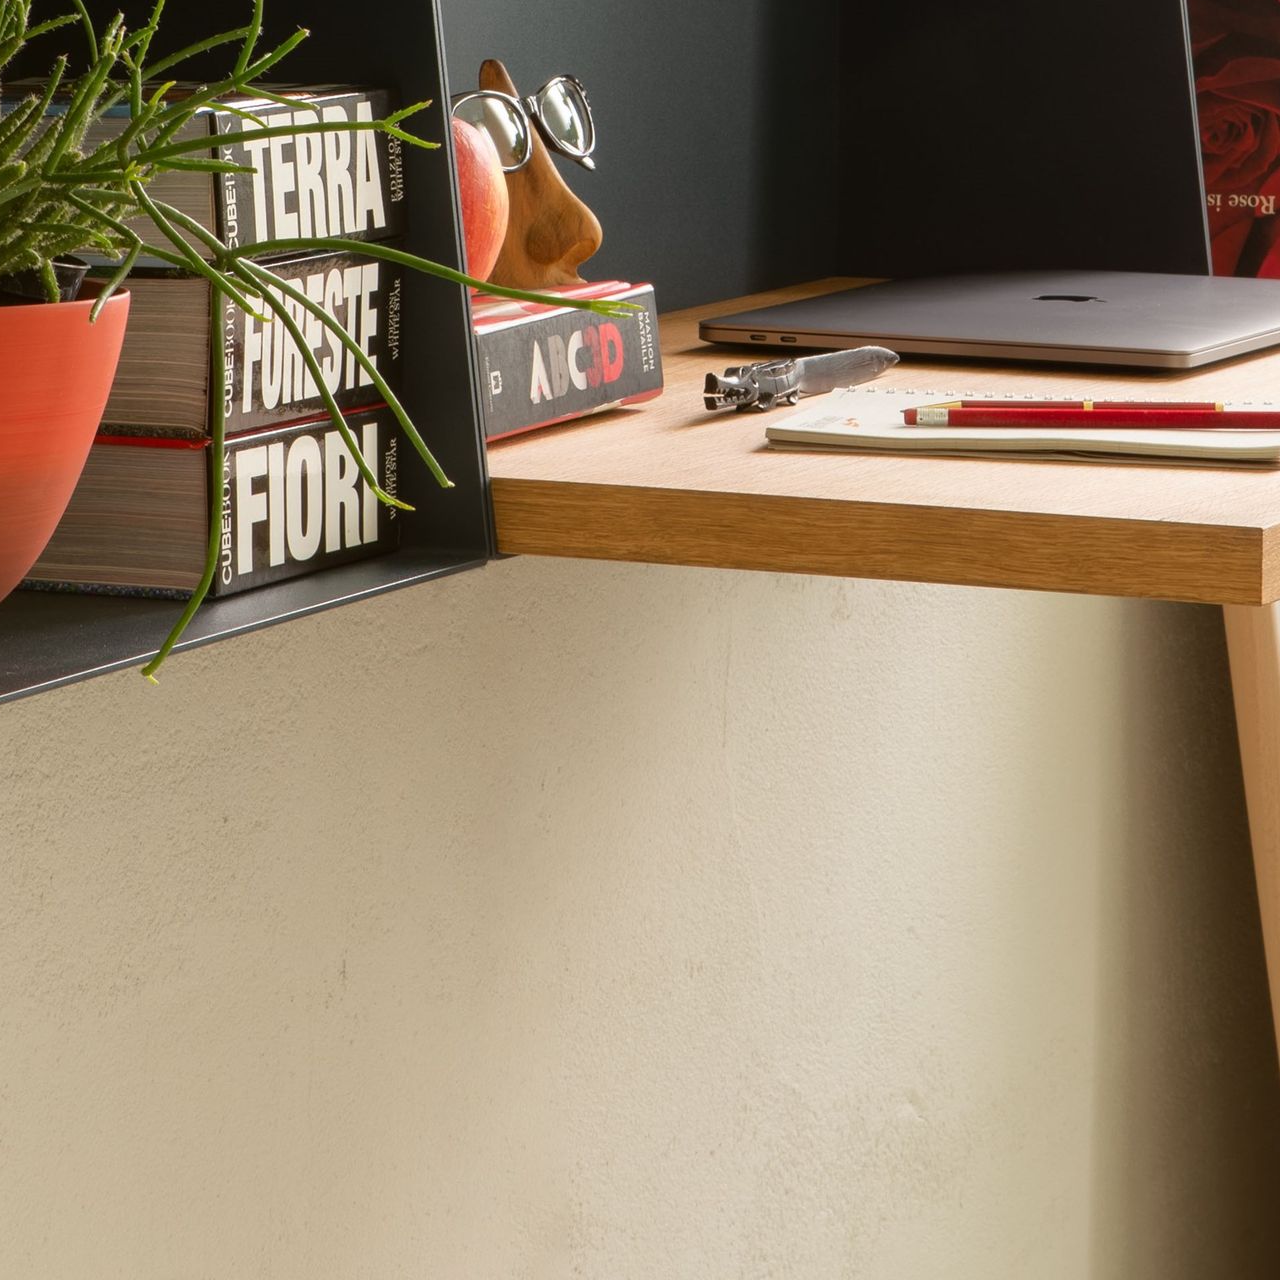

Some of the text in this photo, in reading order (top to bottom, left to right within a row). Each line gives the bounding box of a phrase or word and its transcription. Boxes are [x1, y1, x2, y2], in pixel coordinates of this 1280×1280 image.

[241, 101, 386, 244] TERRA
[387, 132, 397, 202] EDIZION
[393, 122, 404, 201] WHITE STR
[1228, 194, 1276, 215] Rose
[242, 262, 379, 414] FORESTE
[387, 291, 396, 347] EDIZIONI
[392, 278, 401, 361] WHITE STAR
[637, 312, 649, 373] BATAILLE
[644, 311, 655, 370] MARION
[530, 322, 624, 404] ABC3D
[389, 437, 397, 470] STAR
[235, 422, 378, 576] FIORI
